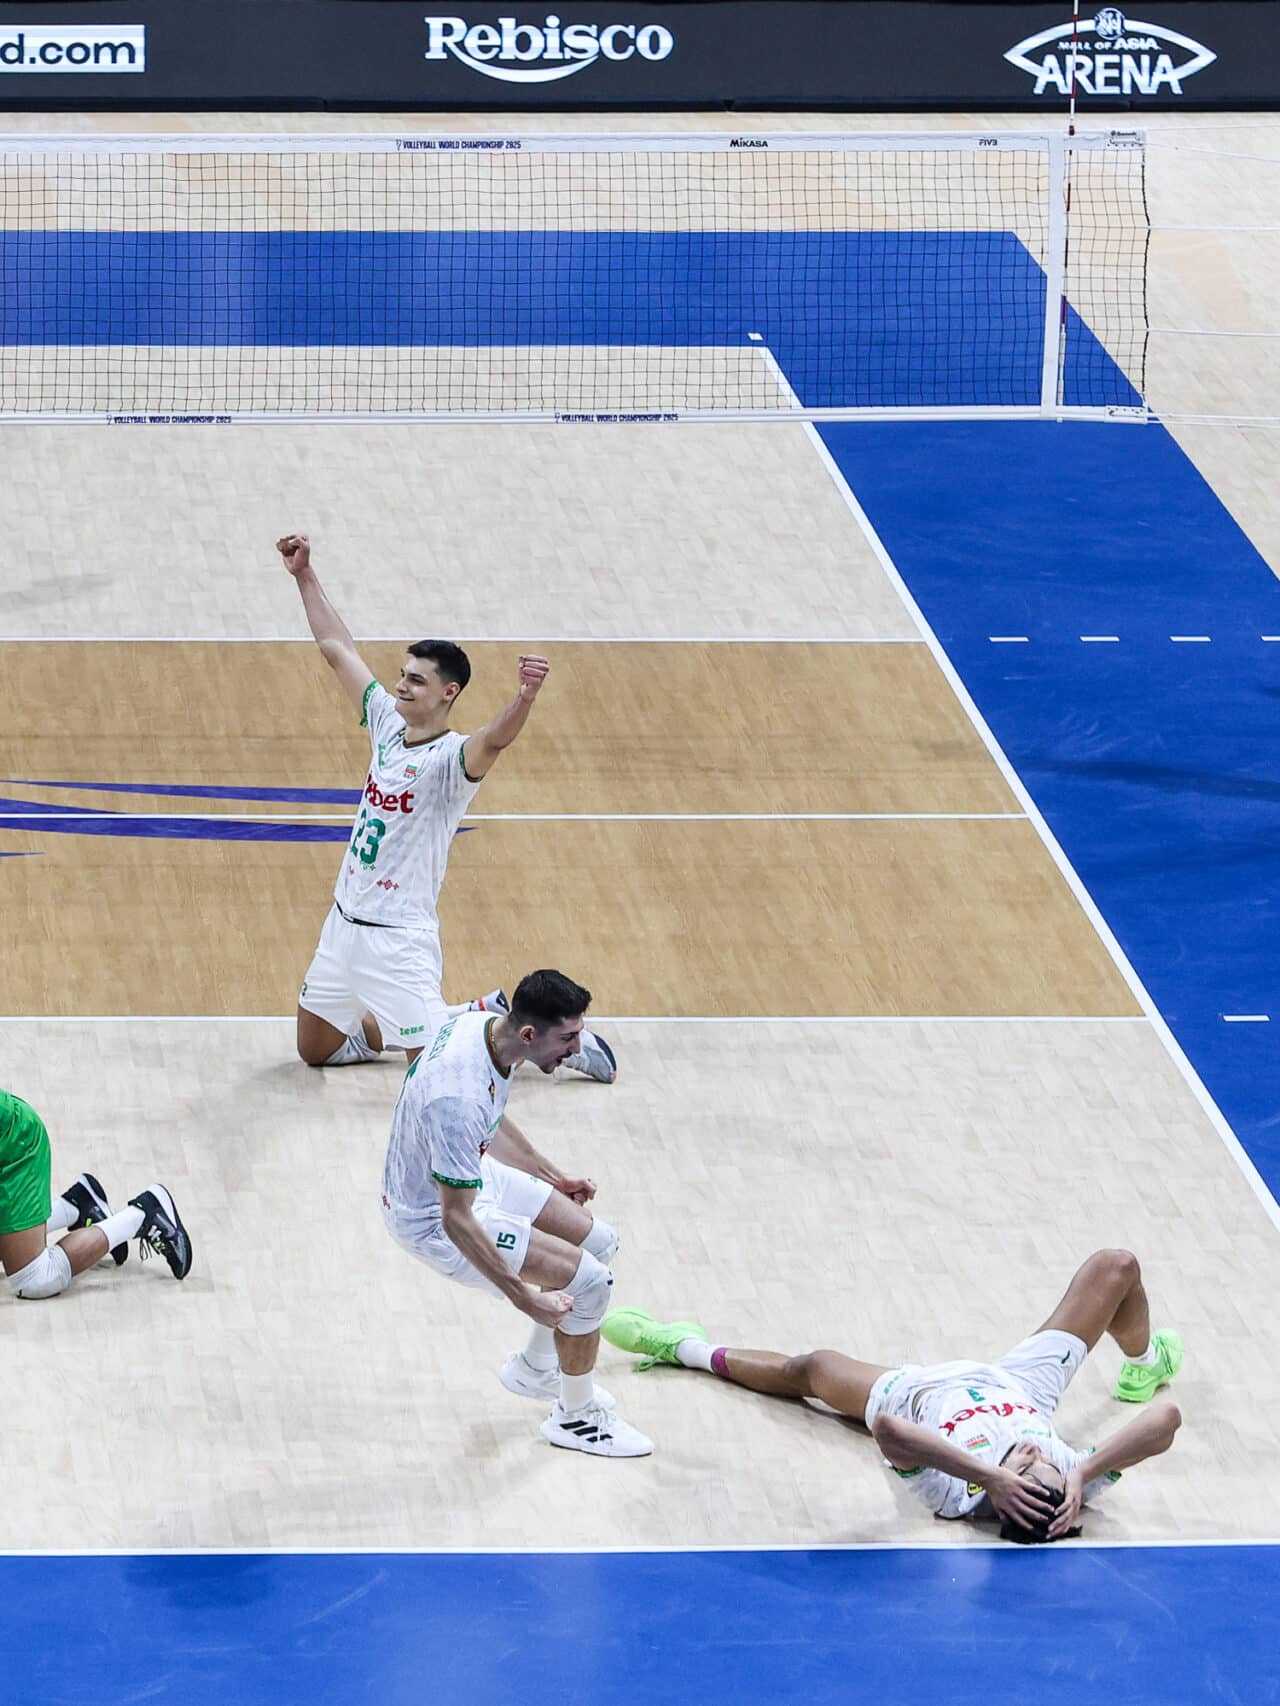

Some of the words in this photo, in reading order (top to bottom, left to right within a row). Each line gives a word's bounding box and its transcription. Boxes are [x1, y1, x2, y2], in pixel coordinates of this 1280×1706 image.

[424, 15, 674, 61] Rebisco
[1094, 41, 1112, 50] OF
[1113, 37, 1161, 50] ASIA
[1033, 54, 1183, 95] ARENA
[403, 140, 436, 149] VOLLEYBALL
[438, 140, 460, 149] WORLD
[461, 140, 504, 149] CHAMPIONSHIP
[496, 1231, 516, 1251] 15
